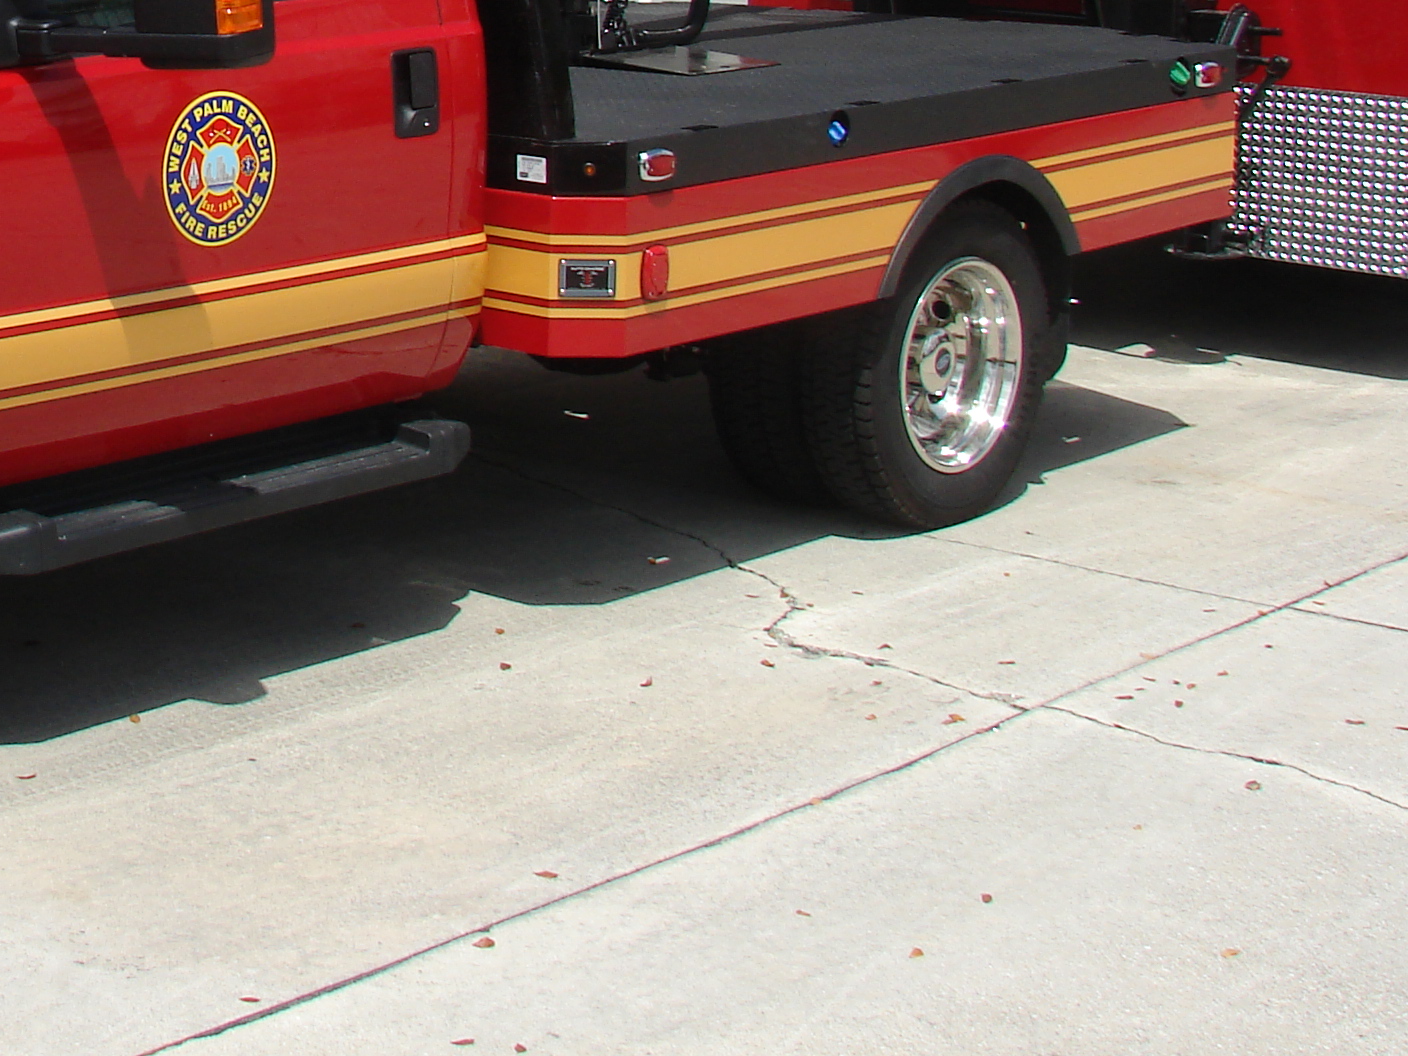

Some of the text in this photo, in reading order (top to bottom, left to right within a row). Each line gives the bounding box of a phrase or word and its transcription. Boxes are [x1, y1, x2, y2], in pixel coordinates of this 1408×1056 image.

[168, 99, 270, 172] WEST PALM BEACH
[175, 193, 263, 239] FIRE RESCUE
